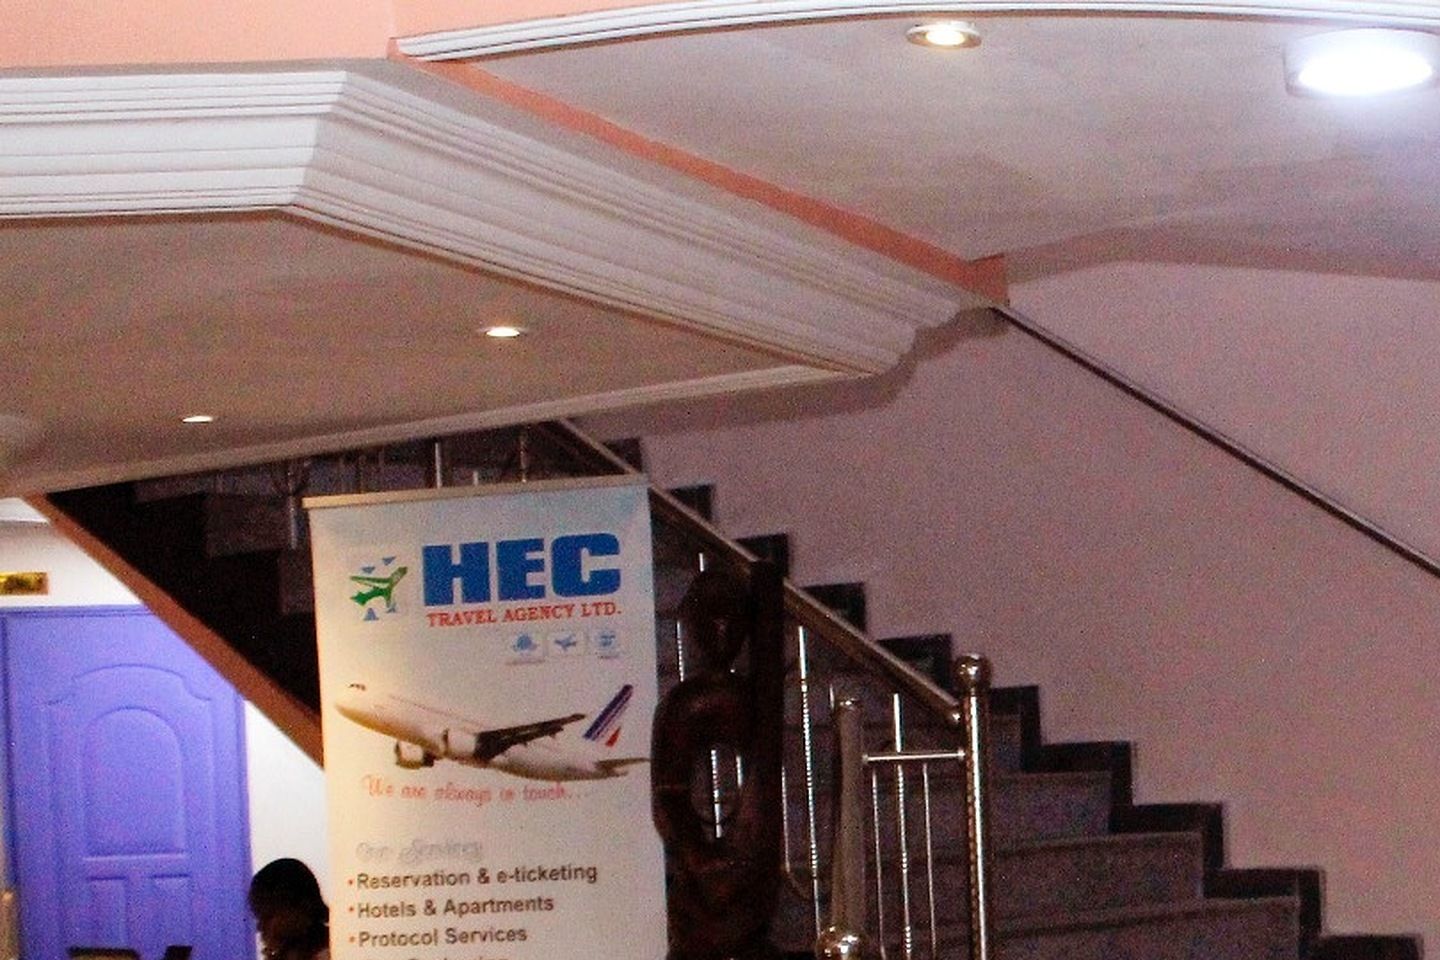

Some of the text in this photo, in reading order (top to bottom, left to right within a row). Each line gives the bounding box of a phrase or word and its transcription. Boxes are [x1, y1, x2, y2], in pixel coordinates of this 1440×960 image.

[422, 533, 621, 606] HEC
[426, 602, 621, 627] TRAVEL AGENCY LTD.
[357, 864, 598, 890] Reservation & e-ticketing
[358, 895, 555, 919] Hotels & Apartments
[359, 926, 528, 948] Protocol Services
